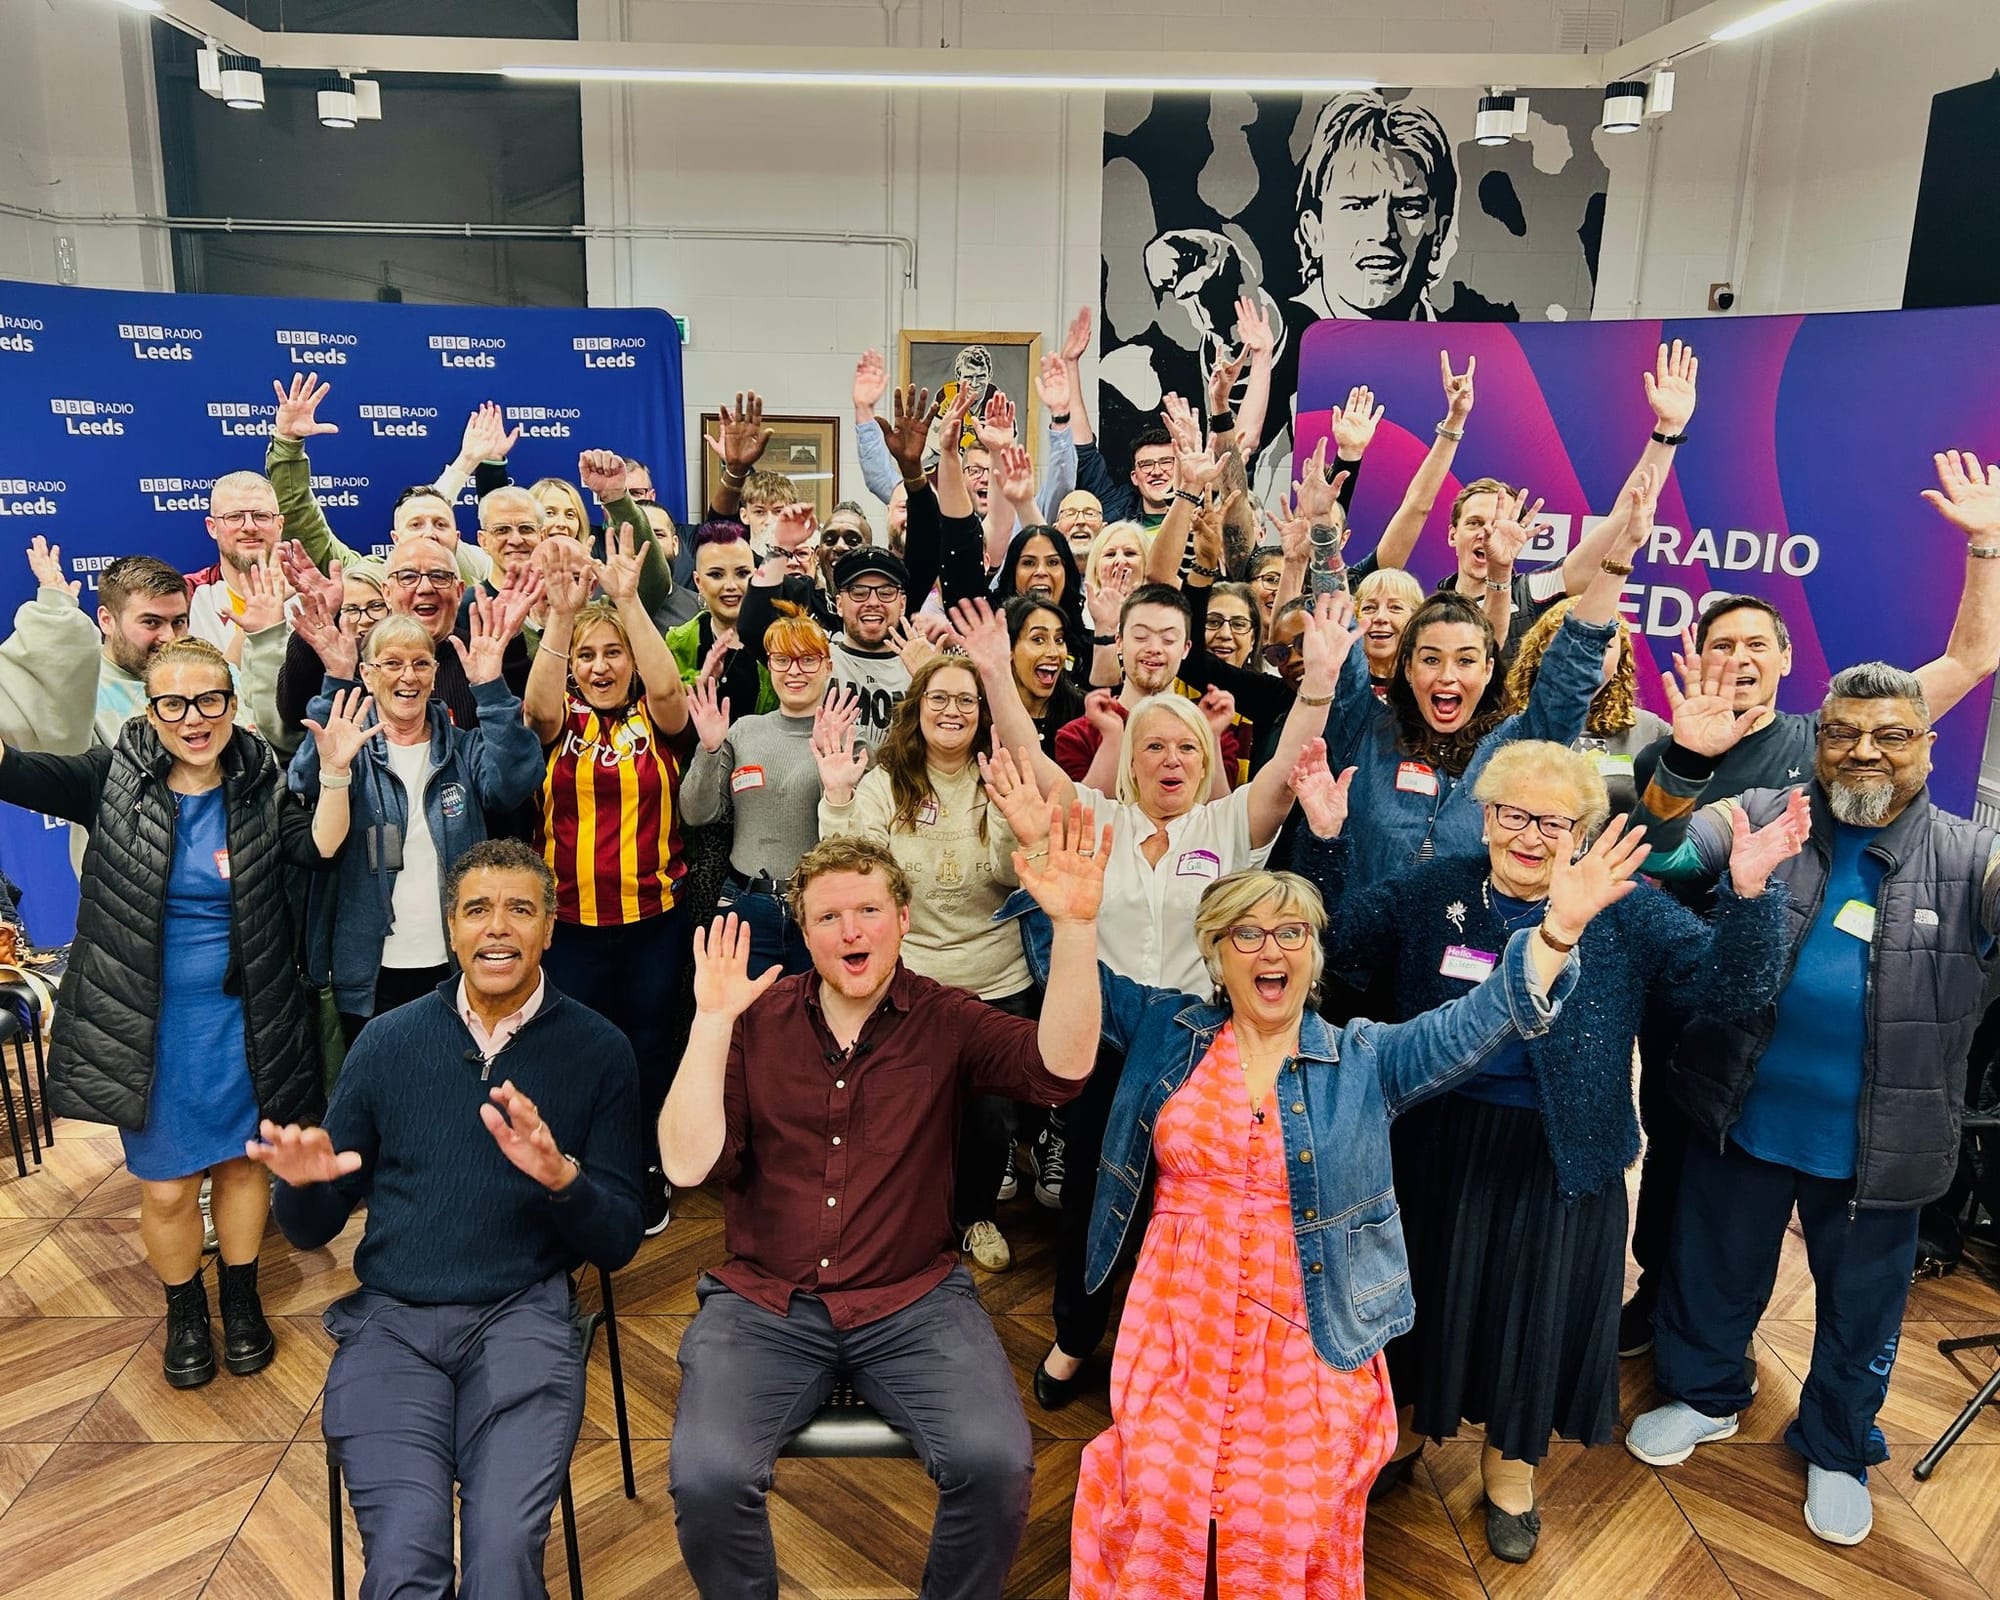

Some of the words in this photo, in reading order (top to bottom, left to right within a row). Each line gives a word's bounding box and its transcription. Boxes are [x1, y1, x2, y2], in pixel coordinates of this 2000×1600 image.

[5, 316, 43, 331] RADIO
[118, 324, 163, 340] BBC
[164, 328, 203, 340] RADIO
[276, 330, 320, 345] BBC
[320, 333, 357, 345] RADIO
[0, 333, 34, 353] eds
[428, 336, 470, 350] BBC
[471, 338, 506, 349] RADIO
[573, 337, 612, 351] BBC
[612, 337, 646, 348] RADIO
[134, 342, 193, 361] Leeds
[290, 347, 347, 365] Leeds
[441, 351, 496, 368] Leeds
[585, 351, 636, 368] Leeds
[50, 399, 96, 415] BBC
[96, 402, 134, 415] RADIO
[207, 403, 251, 417] BBC
[359, 405, 401, 418] BBC
[401, 407, 438, 418] RADIO
[506, 407, 546, 420] BBC
[546, 408, 581, 419] RADIO
[65, 417, 125, 436] Leeds
[372, 420, 428, 437] Leeds
[519, 421, 571, 438] Leeds
[28, 480, 67, 492] RADIO
[139, 478, 183, 493] BBC
[333, 476, 370, 487] RADIO
[0, 496, 57, 516] Leeds
[153, 493, 210, 512] Leeds
[317, 490, 359, 507] eeds
[1647, 523, 1820, 577] RADIO
